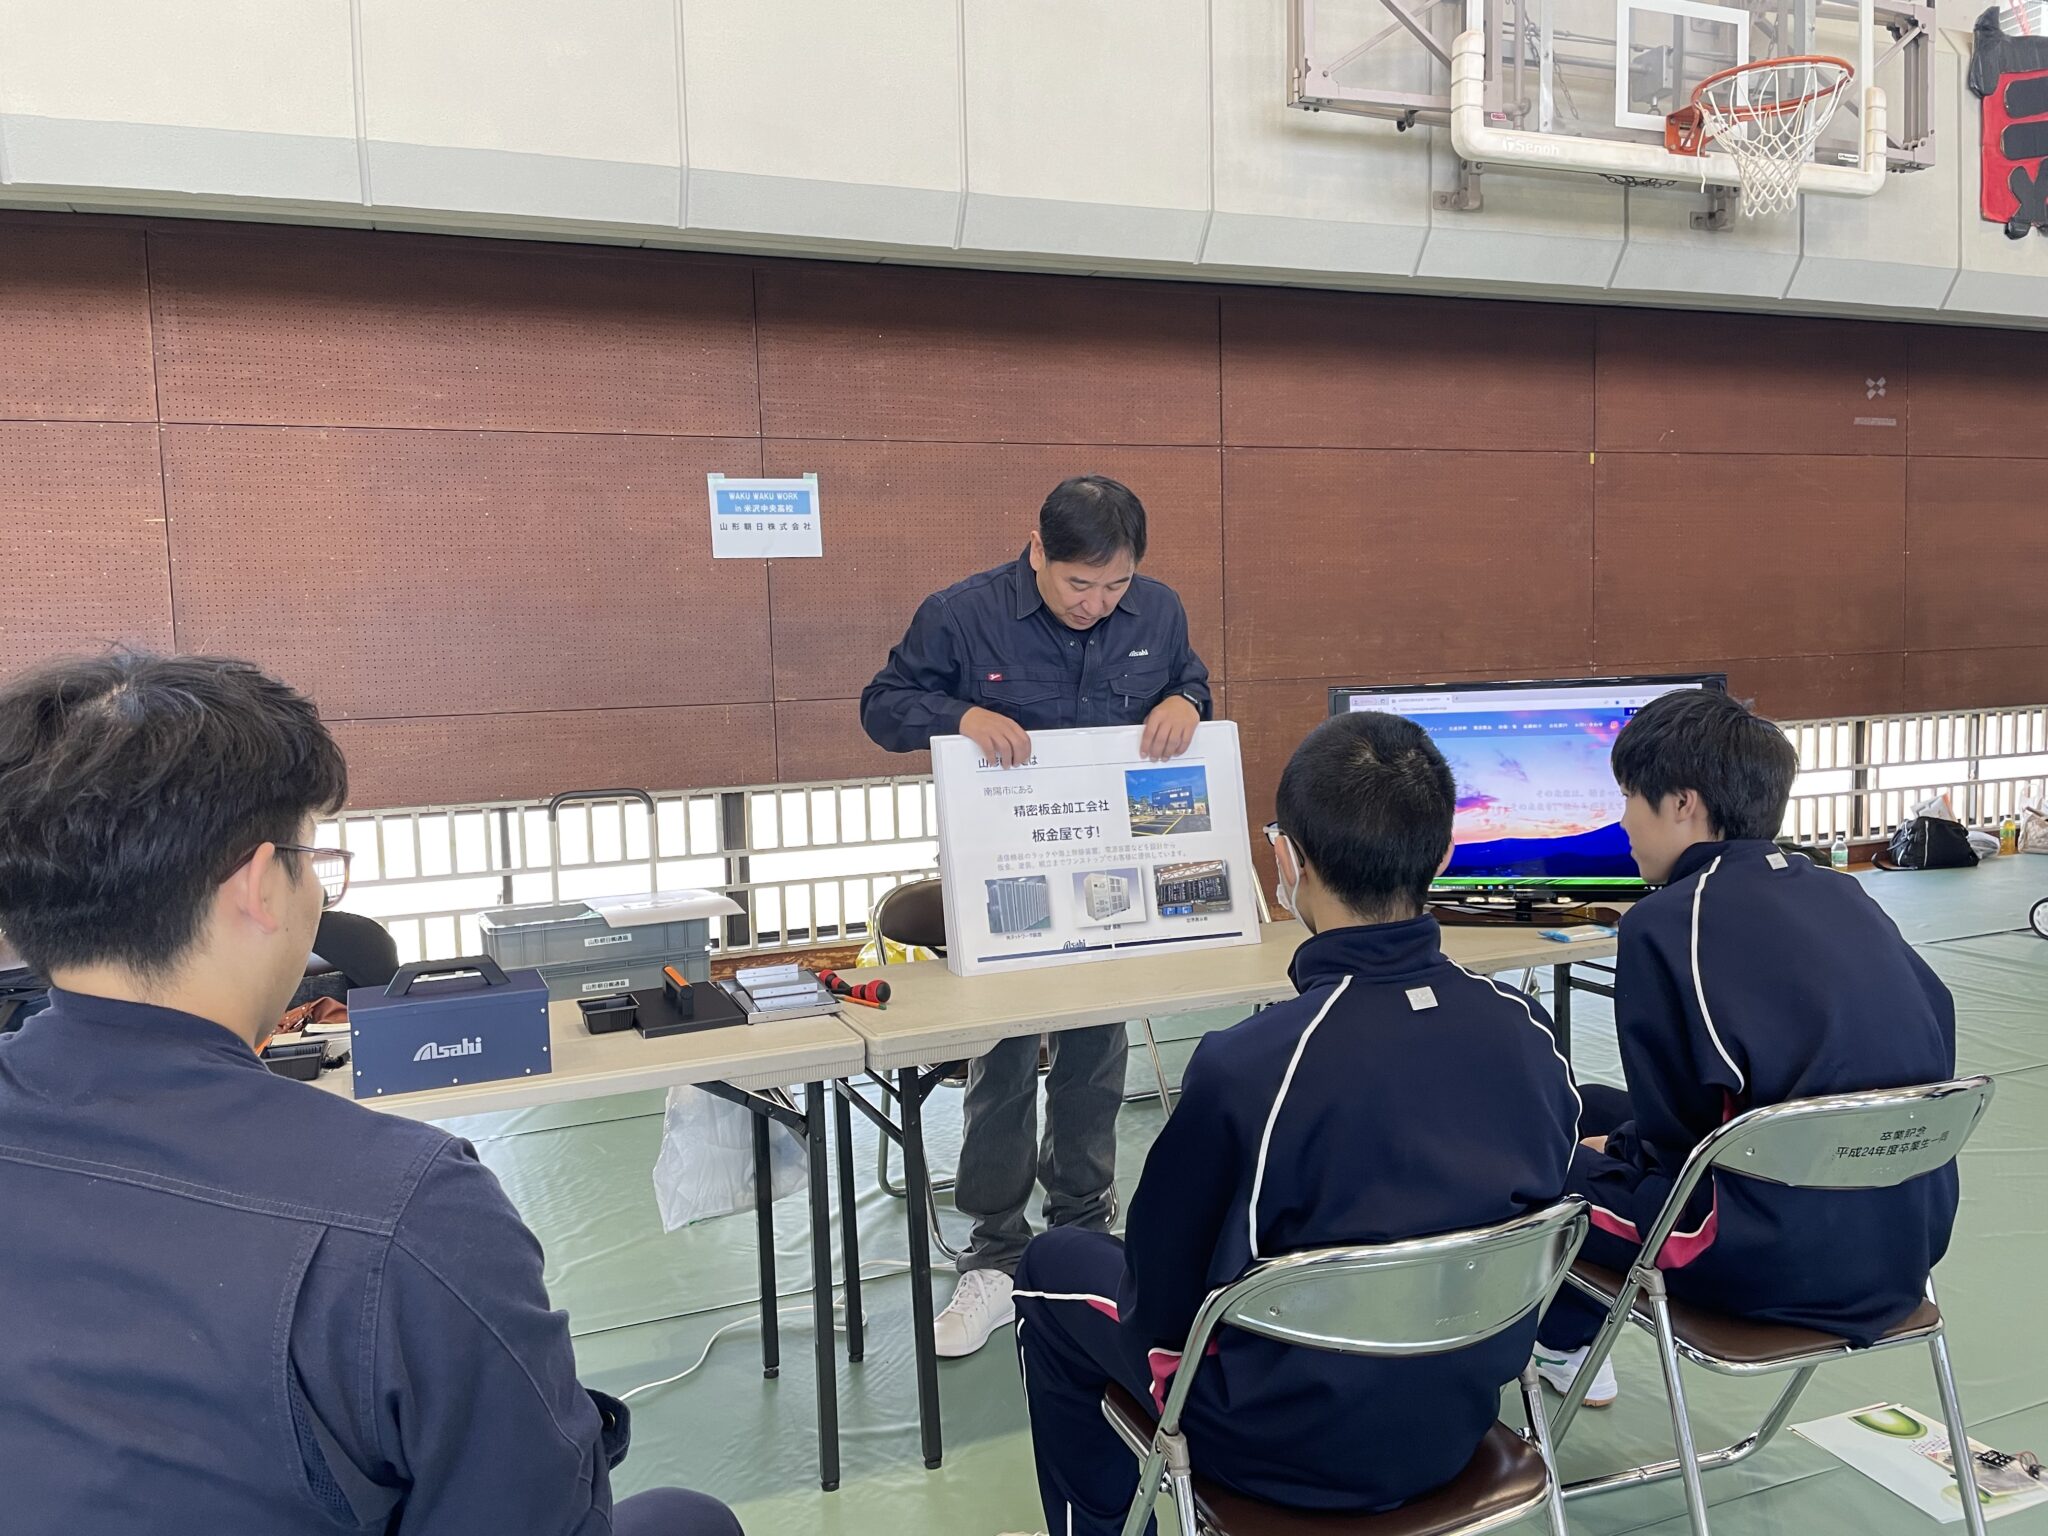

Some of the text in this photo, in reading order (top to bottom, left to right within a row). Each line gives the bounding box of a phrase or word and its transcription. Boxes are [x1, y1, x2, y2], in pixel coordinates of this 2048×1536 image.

[1516, 141, 1559, 155] Senoh
[728, 492, 799, 500] WAKU WAKU WORK
[735, 504, 794, 513] in 米沢中央高校
[719, 522, 811, 531] 山形朝日株式会社
[1128, 648, 1149, 657] Asahi
[983, 784, 1034, 797] 南陽市にある
[1013, 799, 1110, 818] 精密板金加工会社
[413, 1036, 482, 1061] Asahi
[1880, 1126, 1927, 1141] 卒業記念
